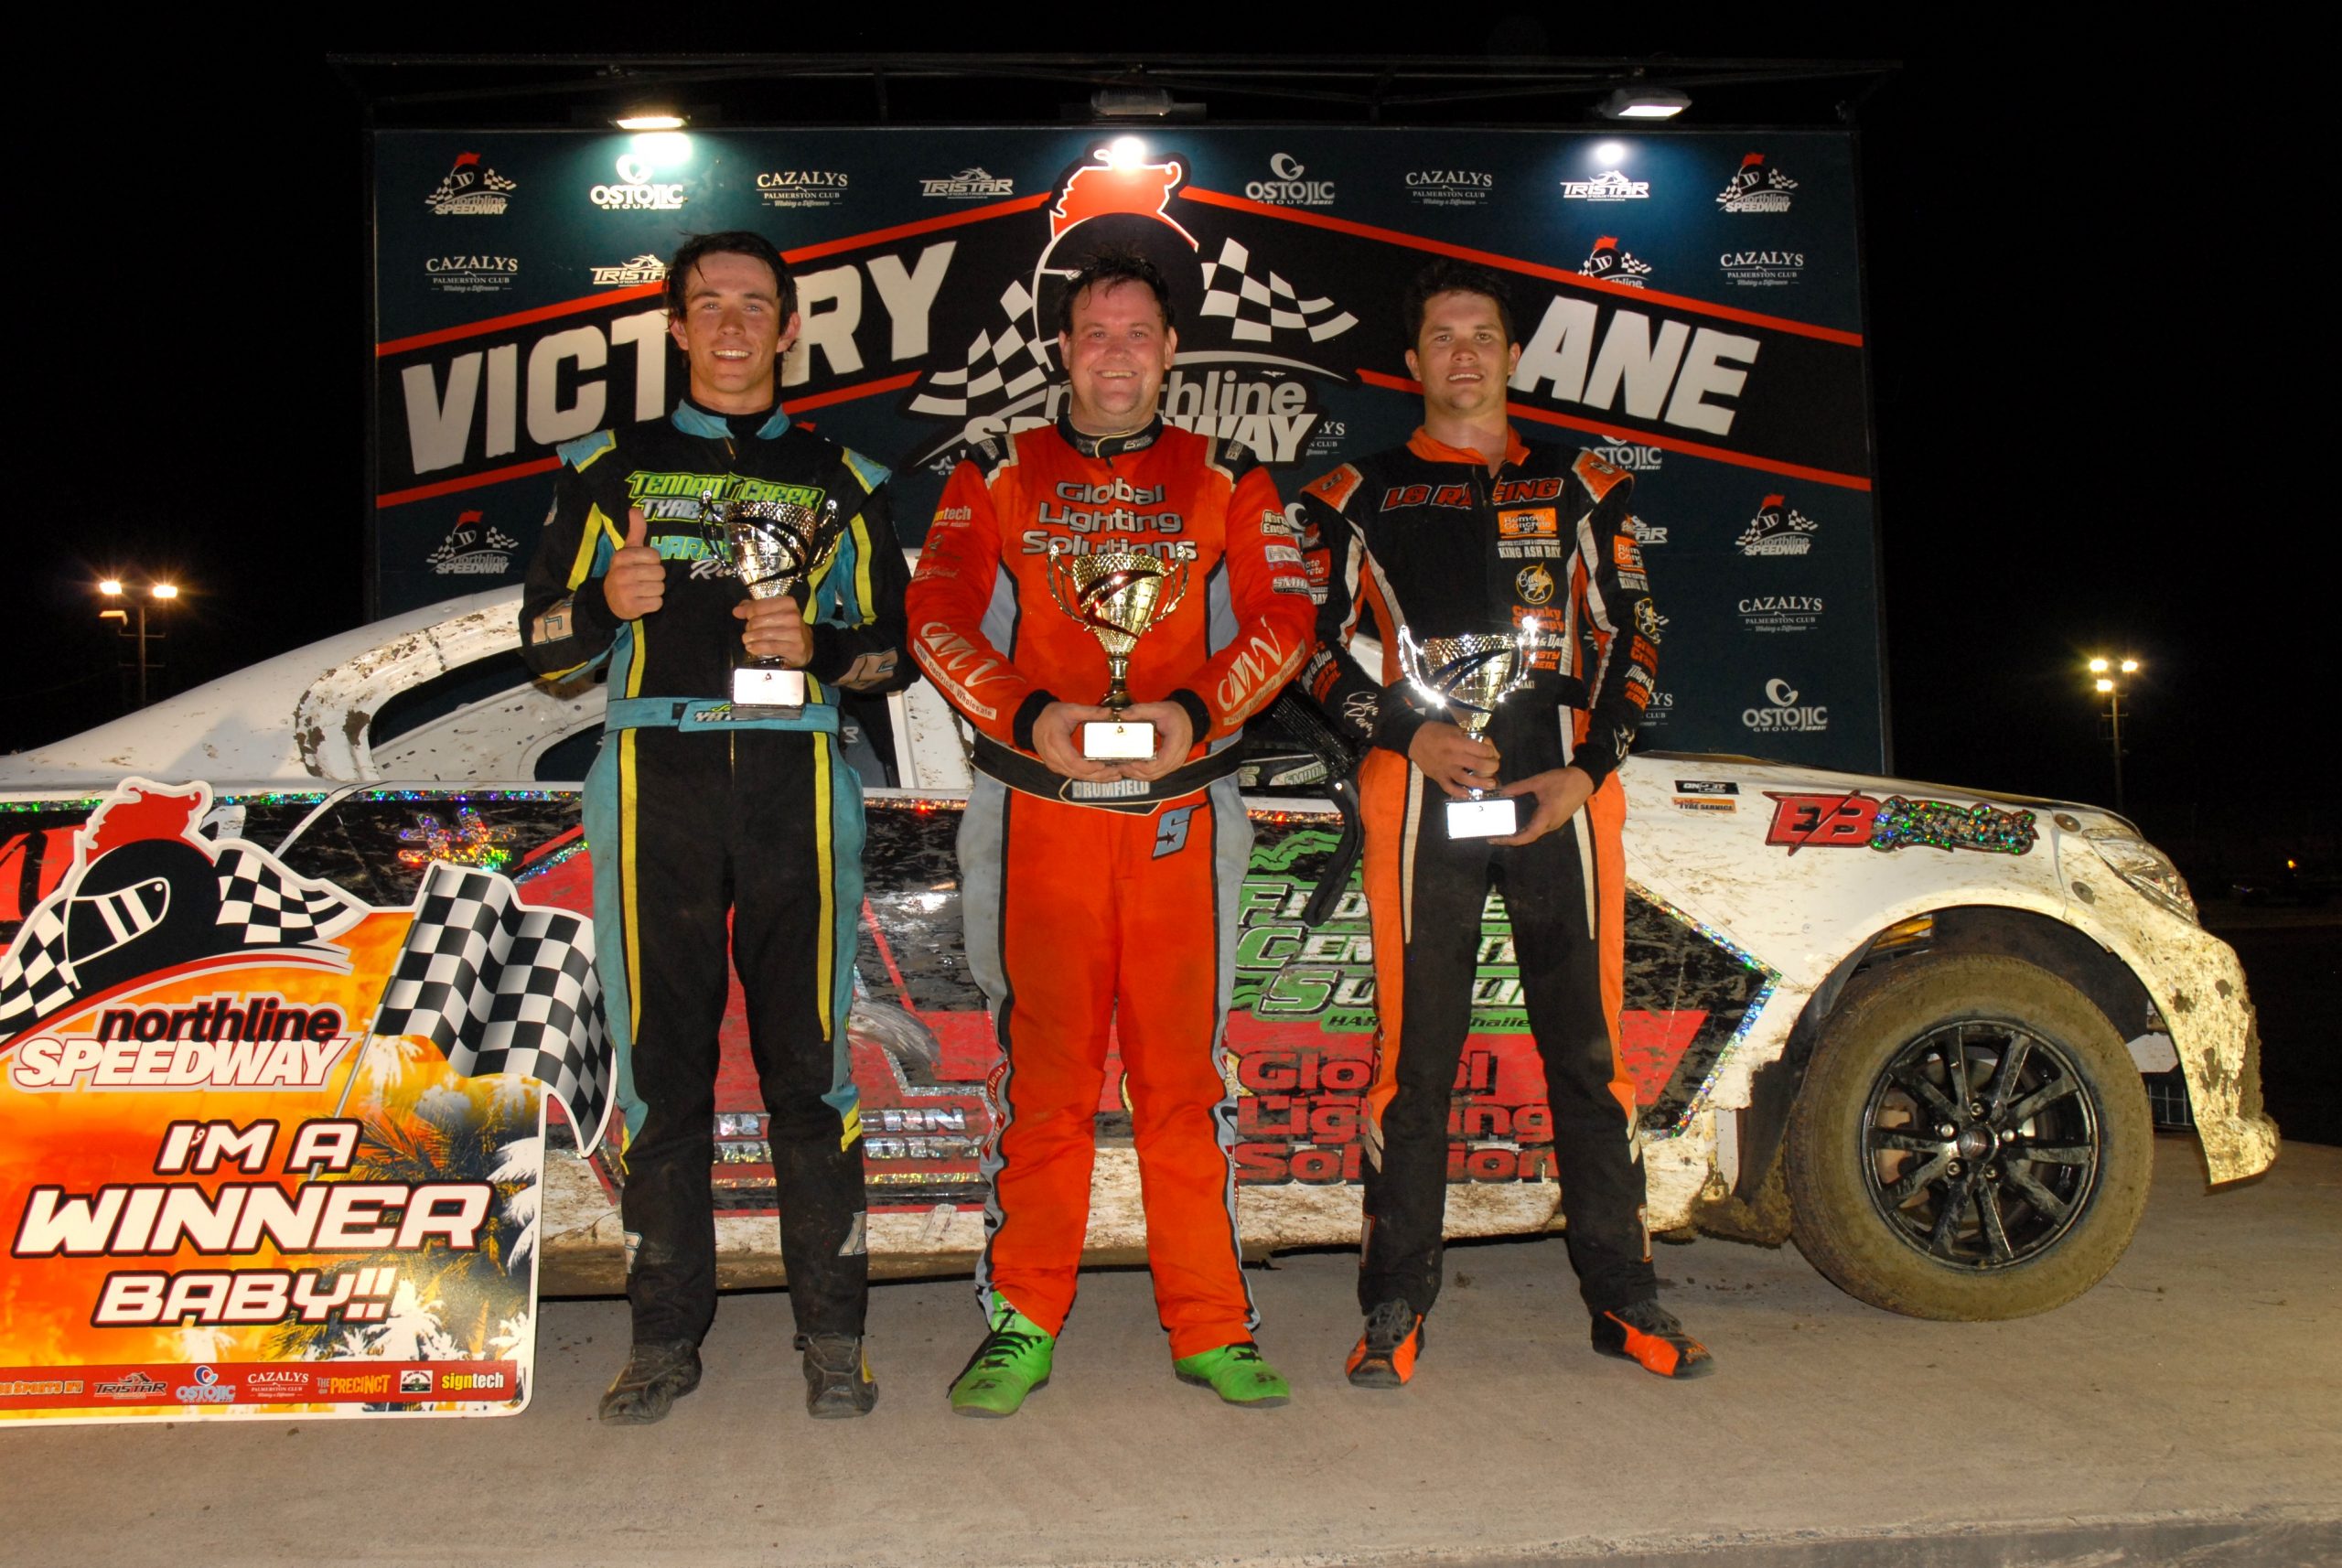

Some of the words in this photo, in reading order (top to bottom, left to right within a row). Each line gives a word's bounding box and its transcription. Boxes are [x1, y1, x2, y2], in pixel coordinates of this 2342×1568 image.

[757, 171, 848, 188] CAZALYS
[919, 178, 1014, 196] TRISTAR
[1406, 170, 1492, 187] CAZALYS
[590, 185, 683, 209] OSTOJIC
[1245, 181, 1335, 205] OSTOJIC
[1560, 181, 1649, 199] TRISTAR
[1741, 194, 1789, 202] northline
[435, 204, 508, 215] SPEEDWAY
[452, 195, 506, 206] northline
[1725, 202, 1791, 212] SPEEDWAY
[425, 256, 518, 272] CAZALYS
[1720, 252, 1803, 267] CAZALYS
[590, 267, 666, 285] TRISTA
[402, 241, 957, 475] VICTRY
[1507, 295, 1760, 436] ANE
[1579, 446, 1662, 470] STOJIC
[1056, 477, 1164, 505] Global
[1038, 501, 1182, 533] Lighting
[1022, 531, 1198, 560] Solutions
[1745, 543, 1810, 555] SPEEDWAY
[1759, 536, 1810, 545] northline
[454, 553, 509, 564] northline
[1499, 547, 1522, 559] KING
[1523, 546, 1544, 558] ASH
[1544, 546, 1562, 558] BAY
[435, 563, 510, 574] SPEEDWAY
[1738, 596, 1822, 613] CAZALYS
[1742, 706, 1828, 732] OSTOJIC
[1072, 780, 1150, 799] BRUMFIELD
[99, 997, 342, 1044] northline
[14, 1036, 350, 1088] SPEEDWAY
[154, 1121, 277, 1173] I'M
[287, 1120, 360, 1172] A
[13, 1184, 492, 1256] WINNER
[93, 1267, 398, 1325] BABY!!
[248, 1371, 309, 1384] CAZALYS
[317, 1377, 329, 1388] THE
[330, 1375, 392, 1395] PRECINCT
[441, 1372, 504, 1391] signtech
[93, 1382, 168, 1397] TRISTAR
[176, 1385, 236, 1402] OSTOJIC
